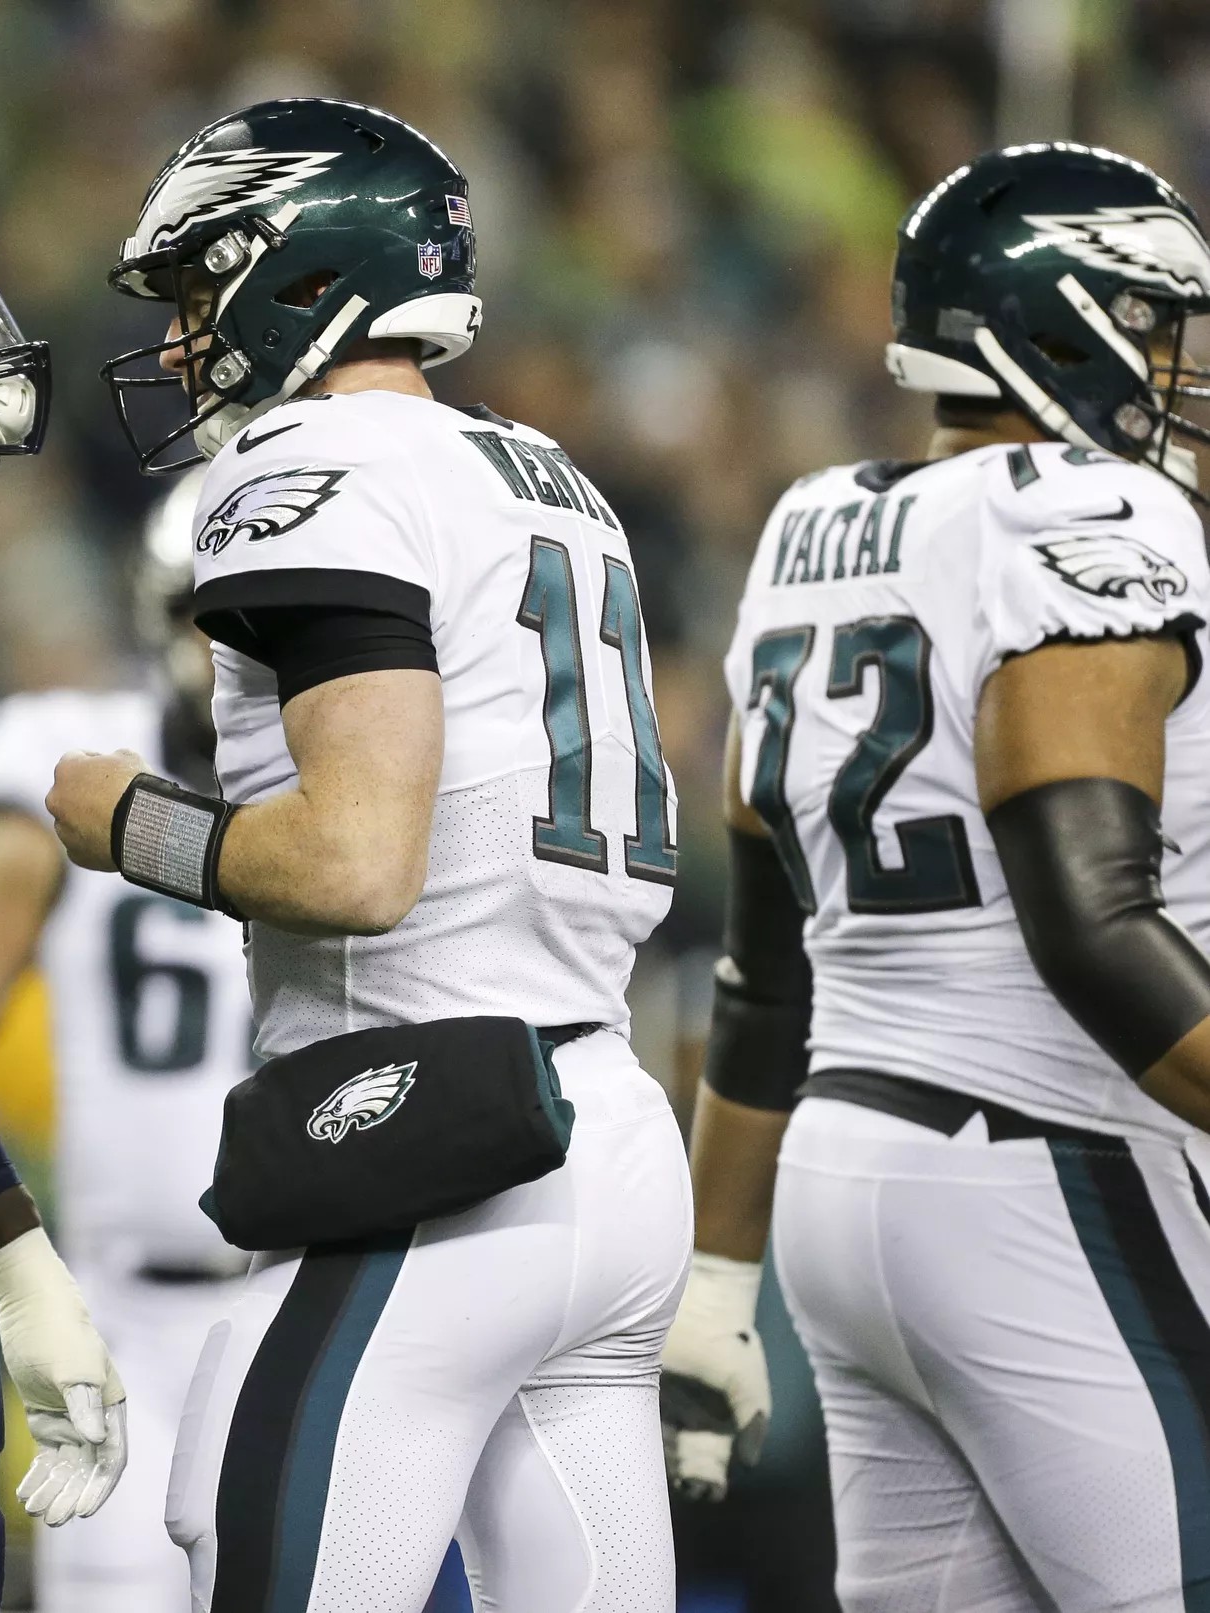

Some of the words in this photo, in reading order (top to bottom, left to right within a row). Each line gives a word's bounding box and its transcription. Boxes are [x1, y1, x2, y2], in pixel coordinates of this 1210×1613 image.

[422, 258, 439, 273] NFL
[770, 495, 919, 587] VAITAI
[516, 535, 678, 887] 11
[747, 614, 983, 915] 72
[109, 892, 266, 1073] 6
